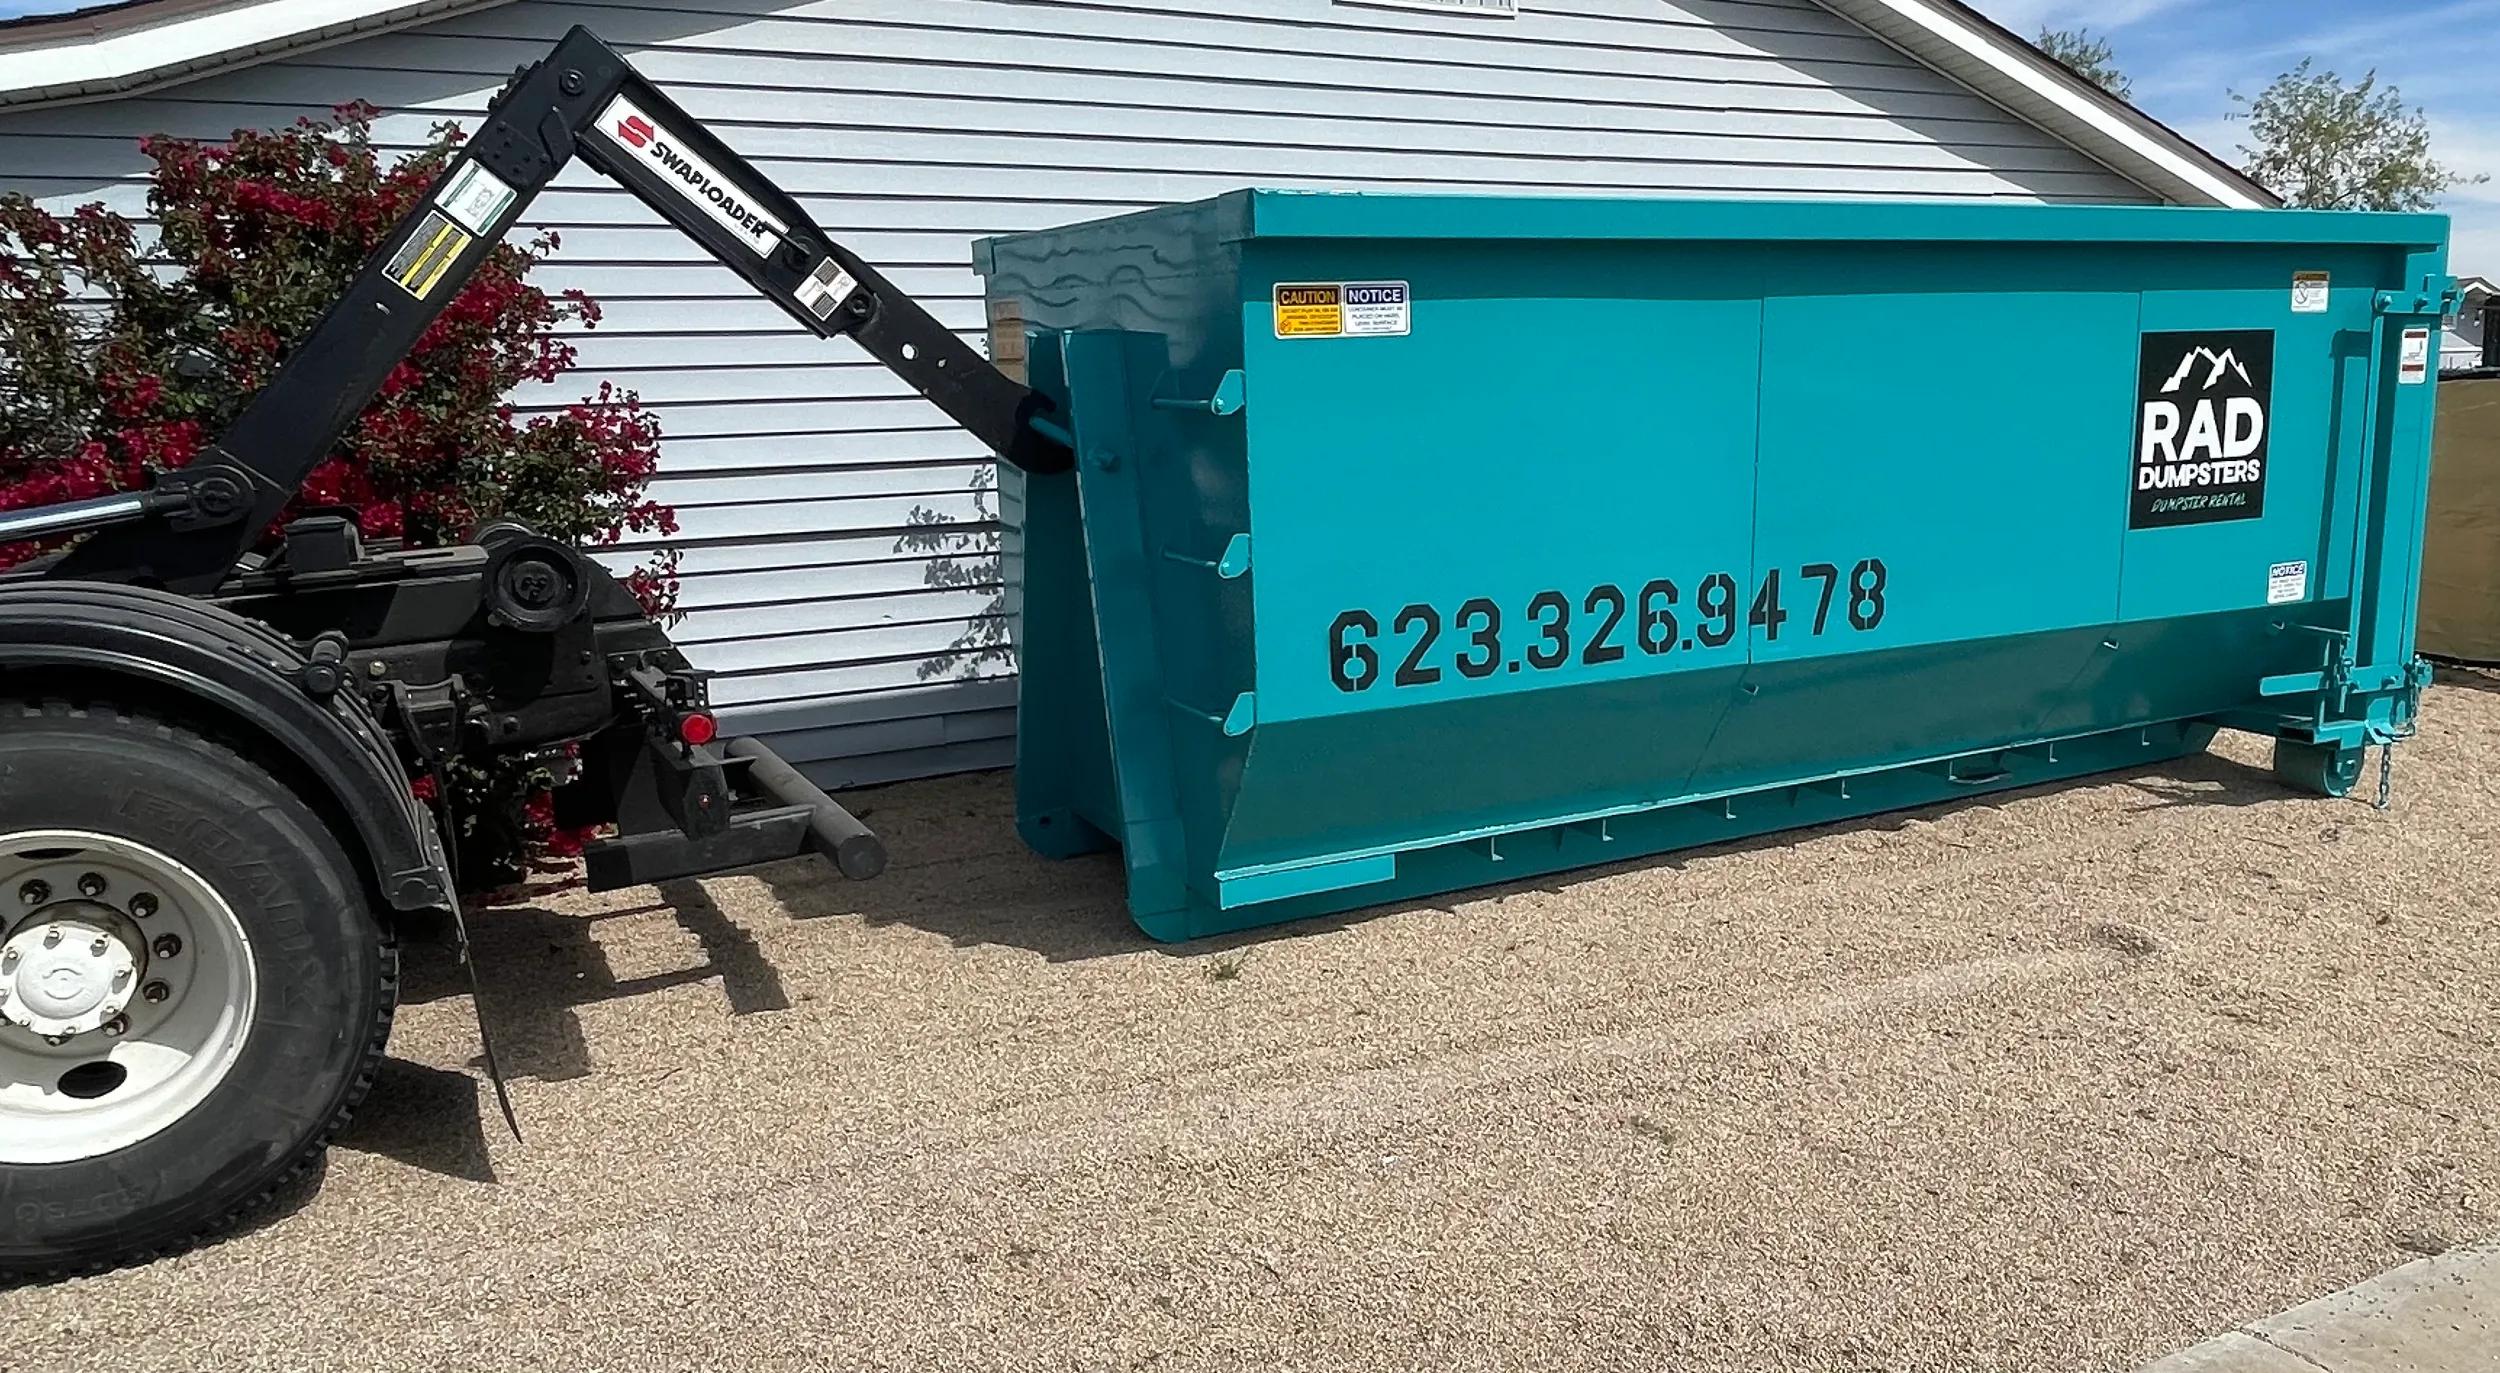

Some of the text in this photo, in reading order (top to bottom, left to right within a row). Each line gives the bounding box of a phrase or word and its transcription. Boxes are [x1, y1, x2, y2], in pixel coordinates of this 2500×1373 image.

[650, 141, 768, 238] SWAPLOADER
[1281, 291, 1336, 304] CAUTION
[1348, 289, 1402, 303] NOTICE
[2140, 397, 2264, 464] RAD
[2138, 459, 2261, 491] DUMPSTERS
[2150, 492, 2247, 513] DUMPSTER RENTAL
[2272, 563, 2304, 577] NOTICE
[1329, 558, 1887, 693] 623.326.9478
